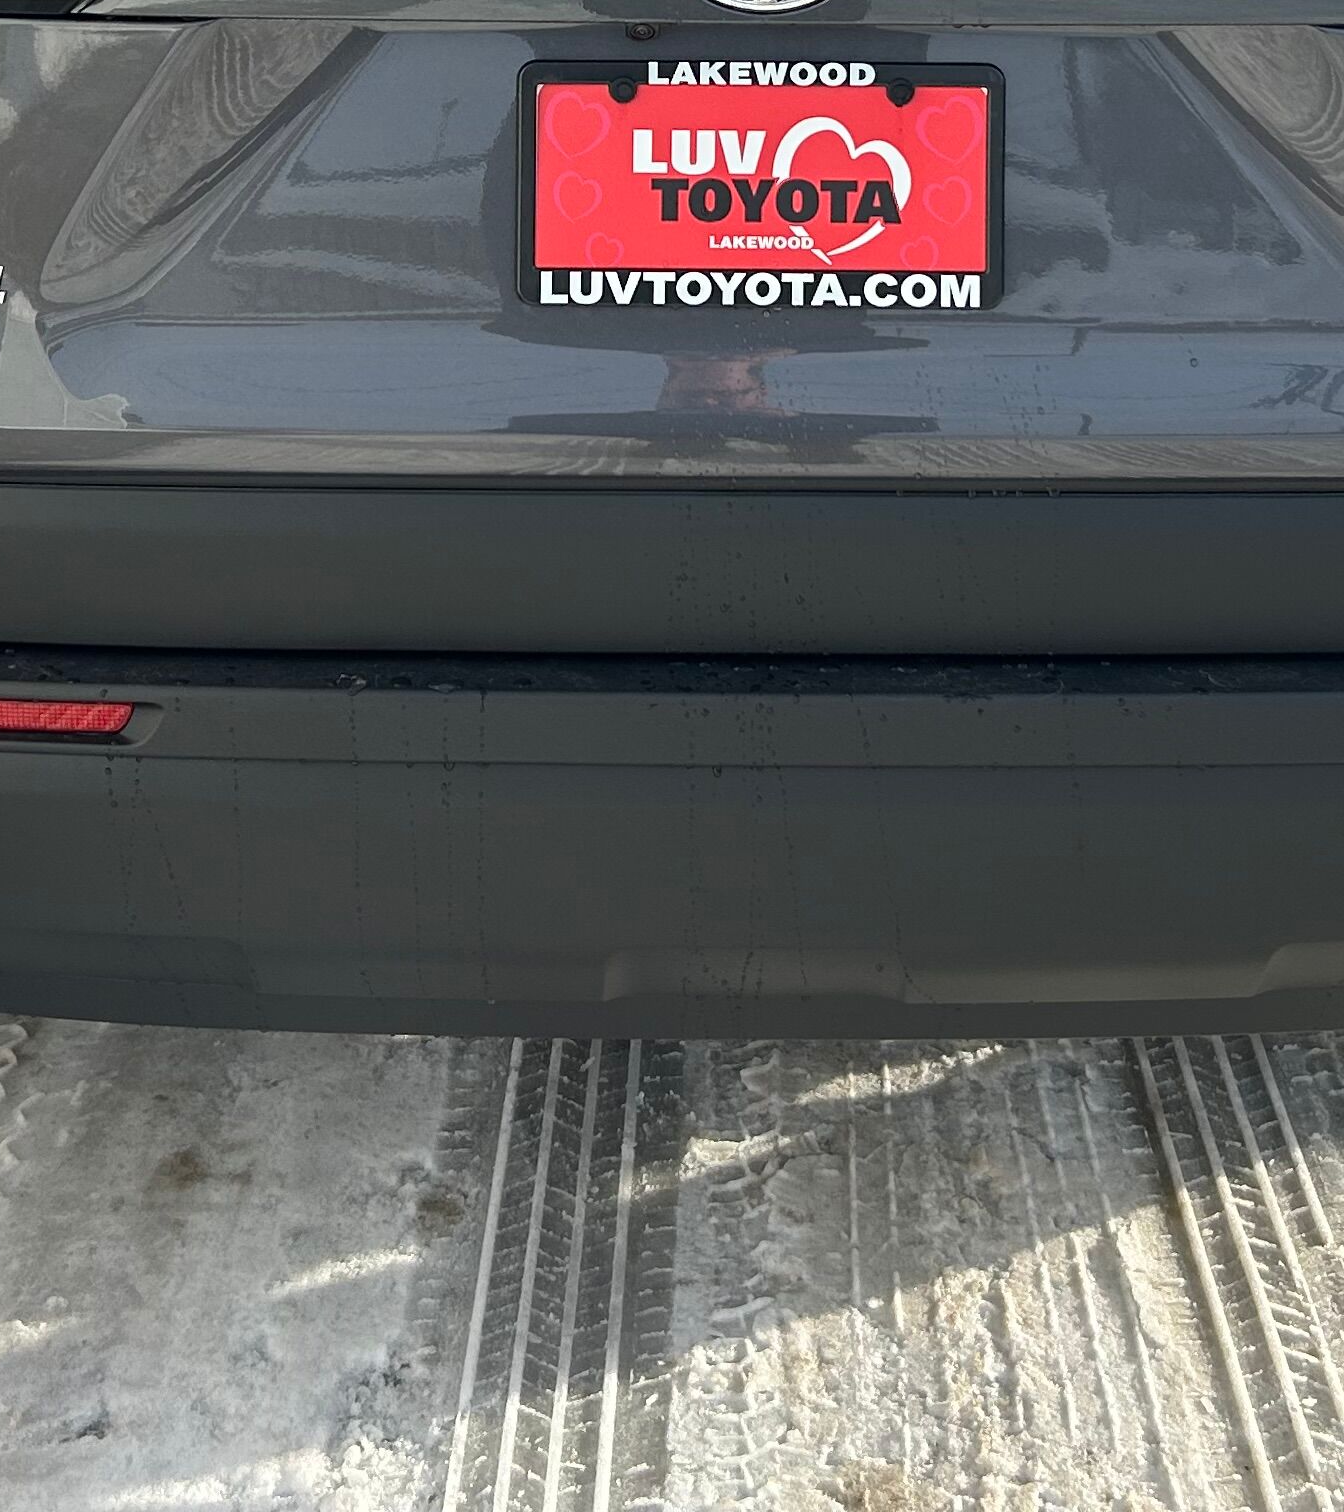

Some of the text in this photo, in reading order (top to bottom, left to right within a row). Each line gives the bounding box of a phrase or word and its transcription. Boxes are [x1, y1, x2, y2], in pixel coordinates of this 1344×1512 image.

[647, 61, 877, 87] LAKEWOOD
[631, 129, 767, 175] LUV
[651, 178, 902, 224] TOYOTA
[708, 235, 815, 251] LAKEWOOD
[539, 270, 981, 309] LUVTOYOTA.COM
